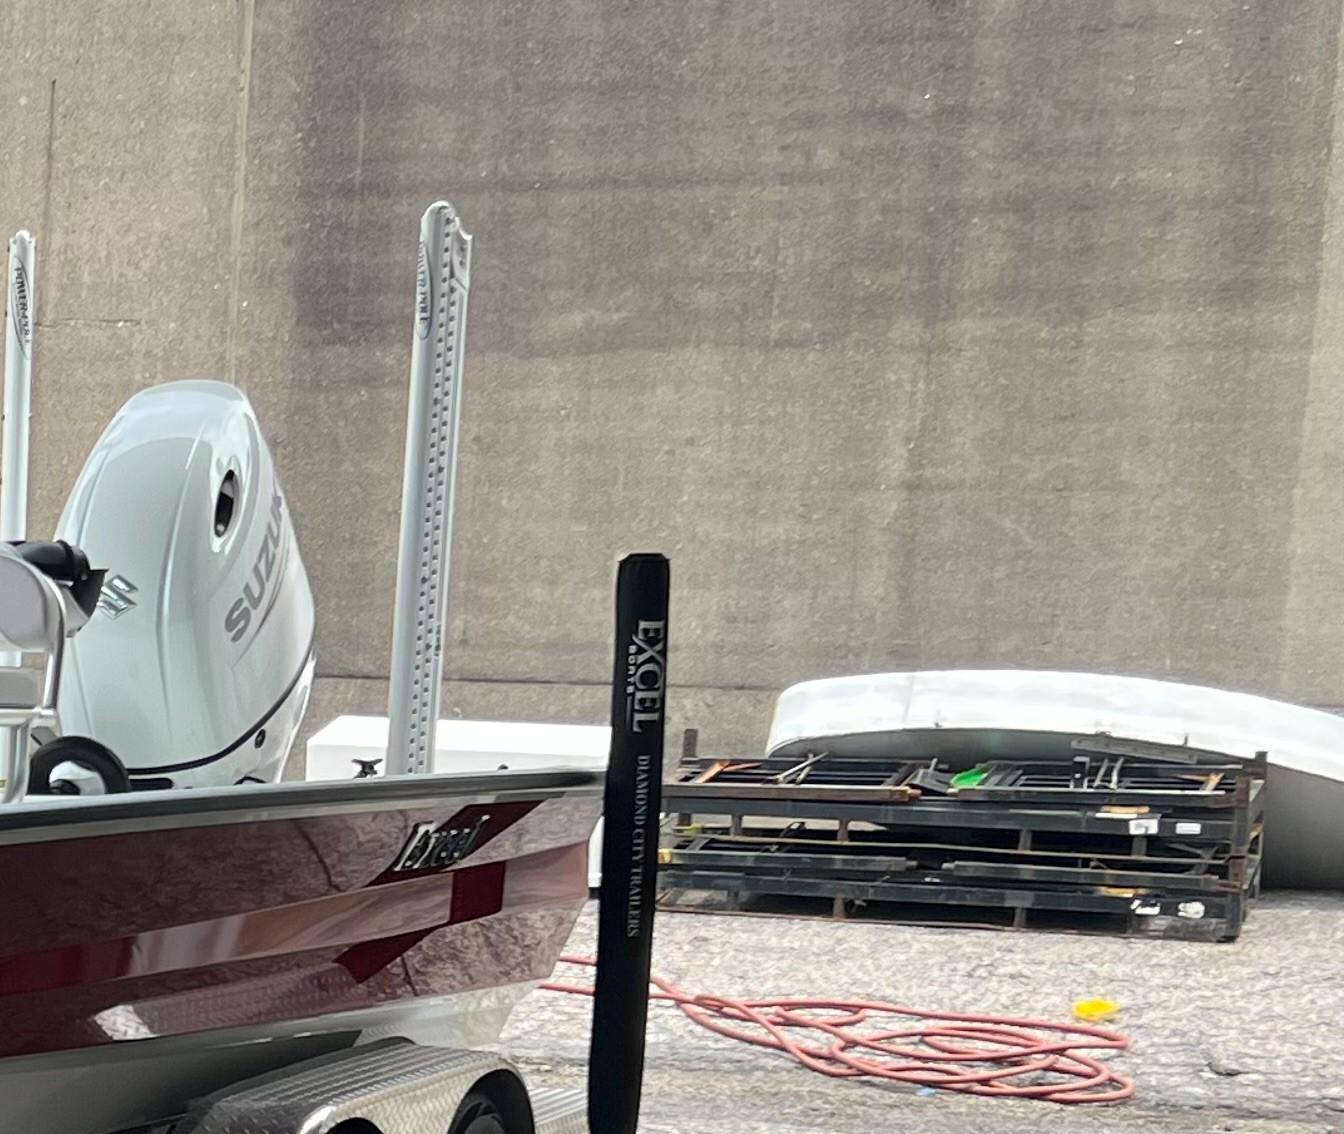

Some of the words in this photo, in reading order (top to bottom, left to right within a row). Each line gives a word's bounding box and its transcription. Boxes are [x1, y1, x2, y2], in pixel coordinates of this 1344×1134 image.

[632, 620, 665, 733] EXCEL
[633, 754, 651, 826] DIAMOND
[631, 828, 646, 862] CITY
[626, 866, 644, 938] TRAILERS
